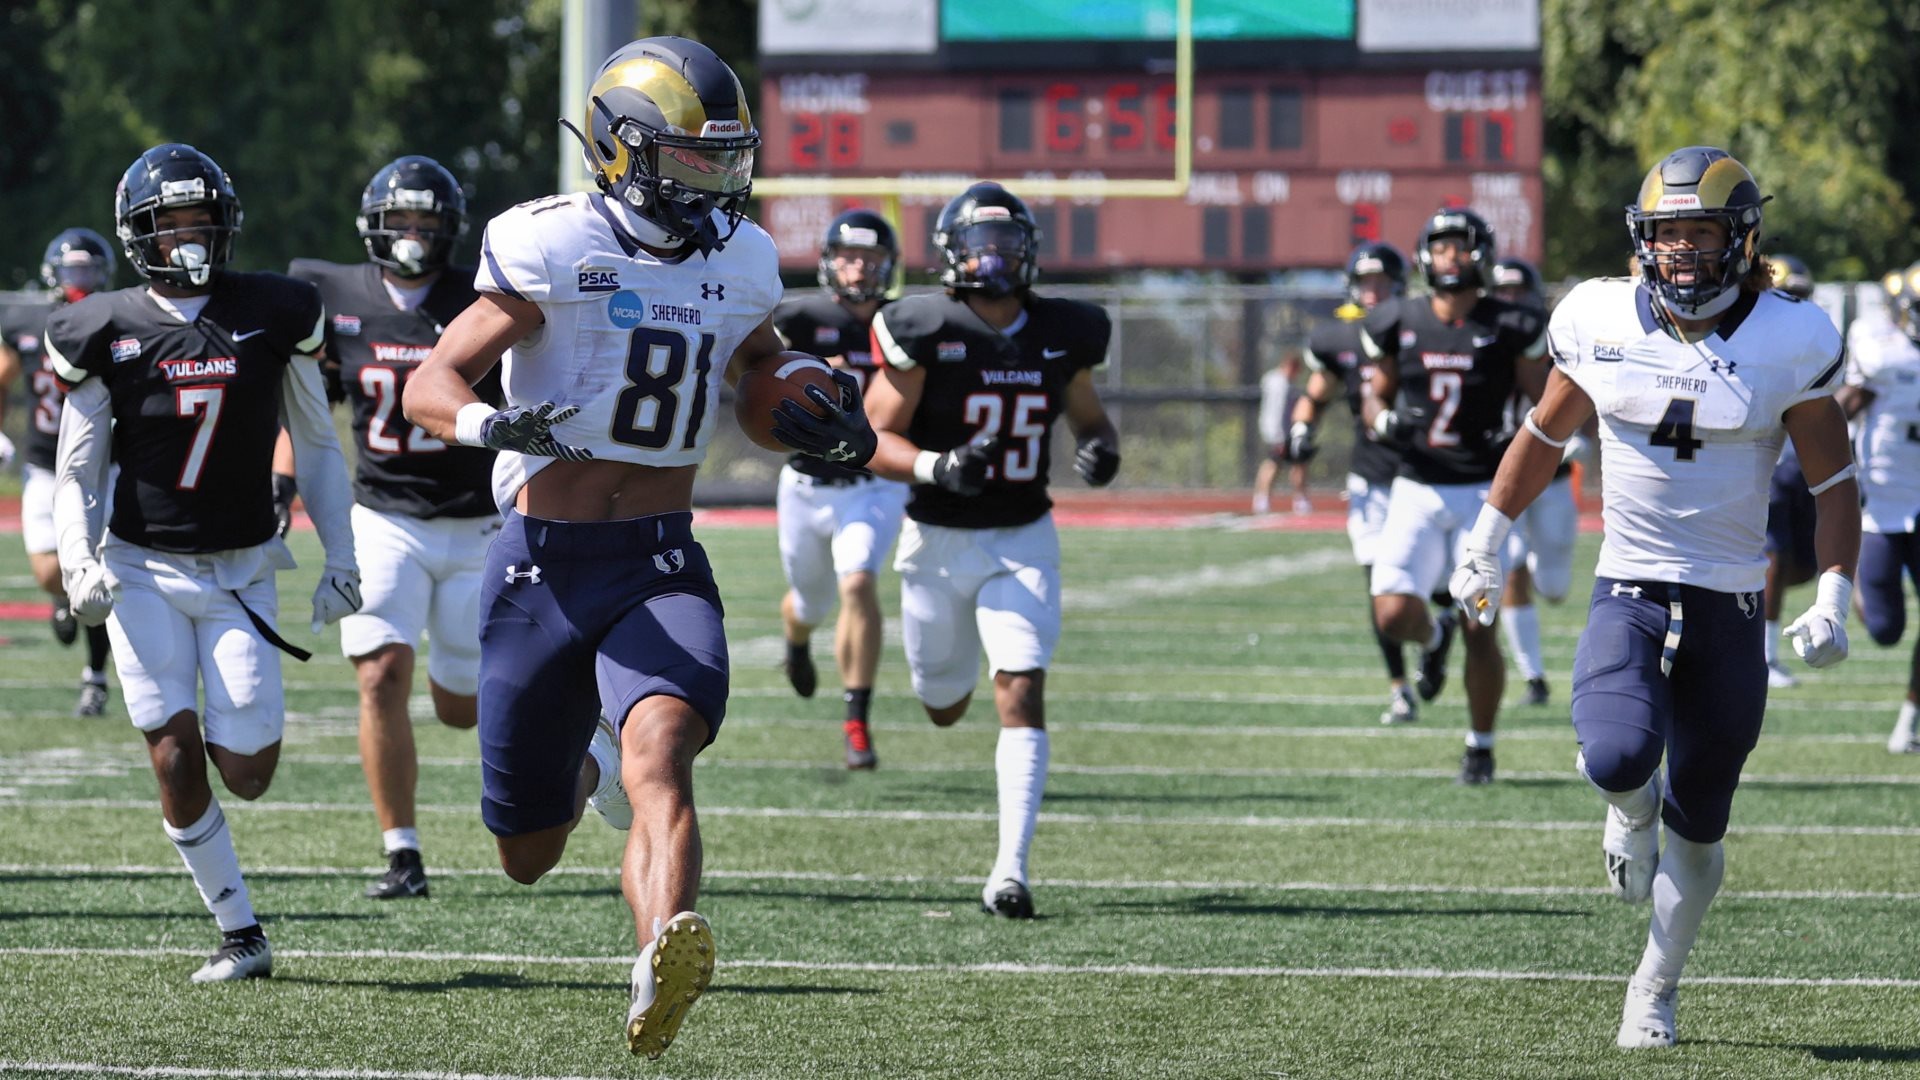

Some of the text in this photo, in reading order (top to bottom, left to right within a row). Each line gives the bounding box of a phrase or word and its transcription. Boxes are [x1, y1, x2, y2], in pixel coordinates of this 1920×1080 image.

[780, 73, 870, 113] HOME
[1424, 71, 1528, 112] GUEST
[709, 123, 741, 133] Riddell
[790, 112, 863, 168] 28
[1462, 110, 1514, 157] 17
[579, 273, 618, 285] PSAC
[612, 307, 641, 320] NCAA
[652, 304, 701, 325] SHEPHERD
[162, 357, 239, 379] VULCANS
[1594, 345, 1624, 357] PSAC
[609, 326, 716, 452] 81
[981, 369, 1043, 386] VULCANS
[1655, 375, 1708, 393] SHEPHERD
[1429, 370, 1463, 447] 2
[177, 384, 225, 492] 7
[964, 392, 1048, 481] 25
[1649, 395, 1704, 463] 4
